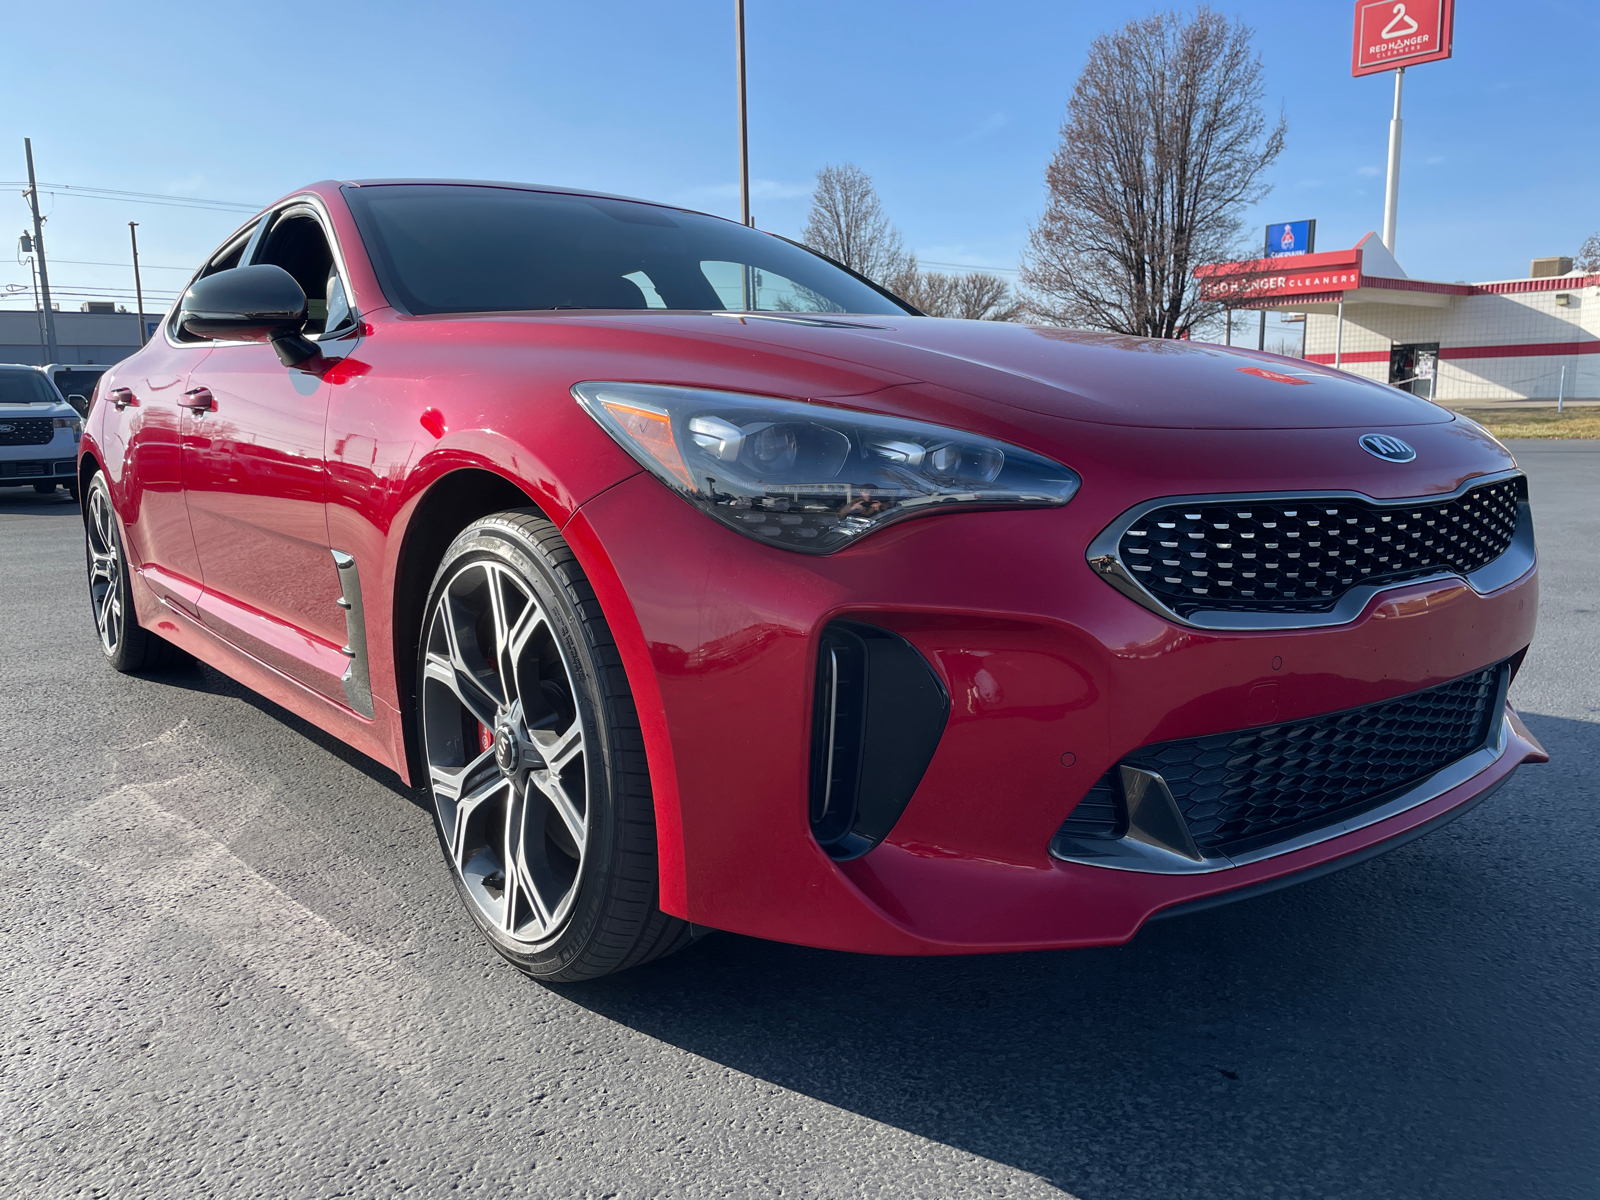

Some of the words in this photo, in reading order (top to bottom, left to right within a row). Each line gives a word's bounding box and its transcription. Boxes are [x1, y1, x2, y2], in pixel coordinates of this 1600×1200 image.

[1369, 43, 1388, 54] RED
[1388, 34, 1430, 50] HANGER
[1376, 45, 1421, 58] CLEANERS
[1288, 274, 1357, 288] CLEANERS
[1365, 436, 1412, 454] KIA
[497, 737, 508, 764] KIA
[561, 894, 600, 962] MICHELIN
